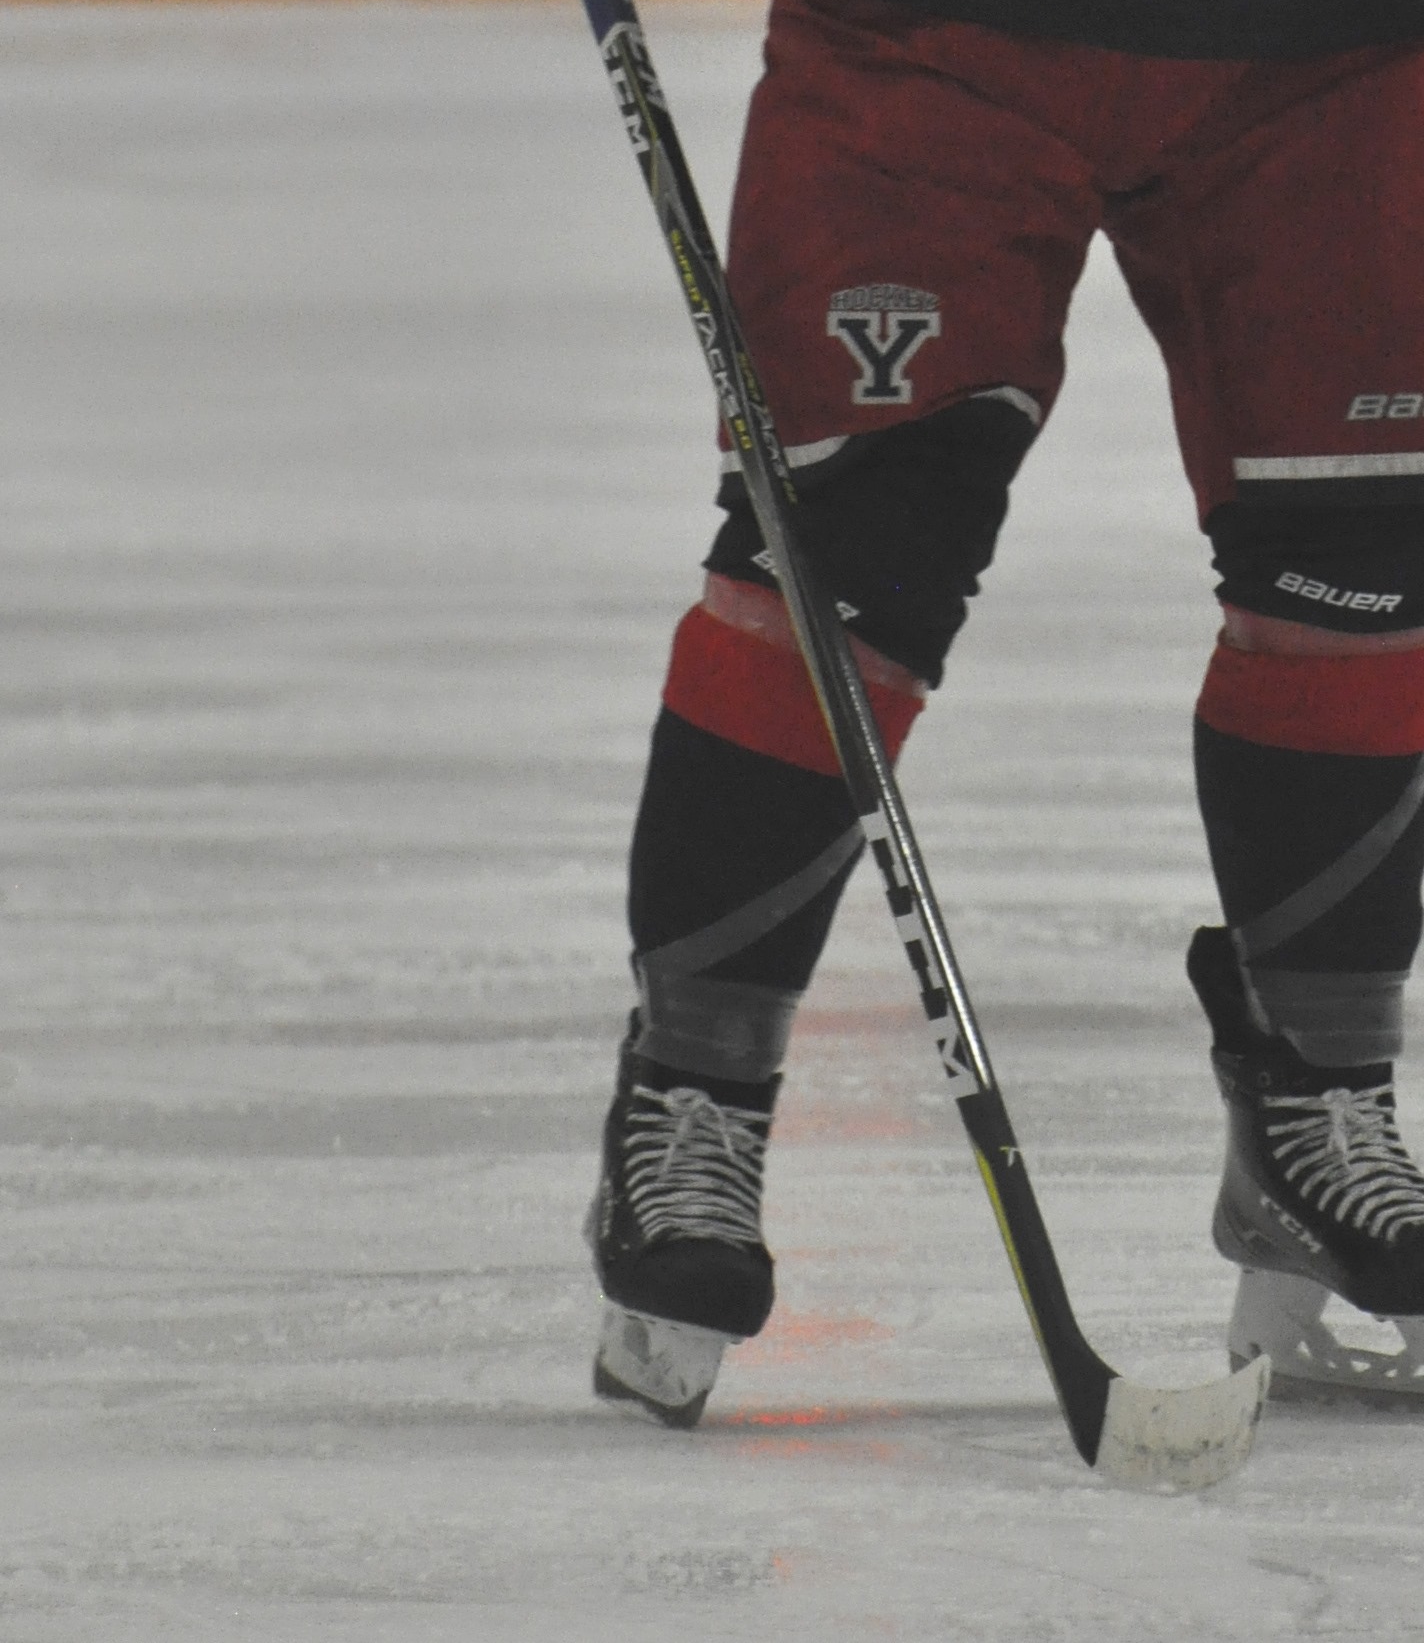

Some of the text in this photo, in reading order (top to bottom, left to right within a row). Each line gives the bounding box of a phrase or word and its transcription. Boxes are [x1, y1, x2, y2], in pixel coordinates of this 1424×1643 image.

[826, 310, 941, 405] Y
[1275, 571, 1403, 613] BAUER
[858, 805, 979, 1100] CCM
